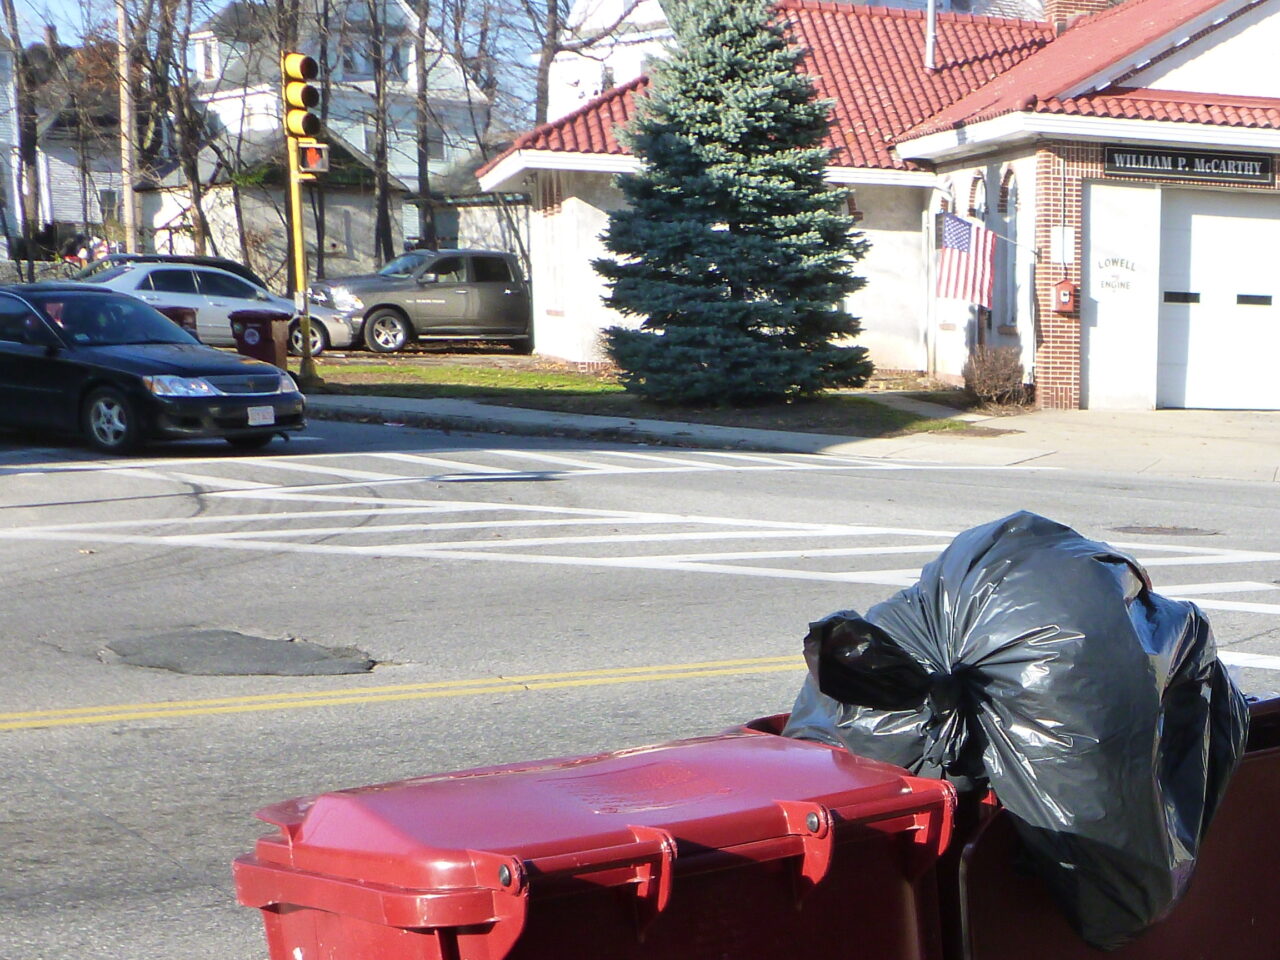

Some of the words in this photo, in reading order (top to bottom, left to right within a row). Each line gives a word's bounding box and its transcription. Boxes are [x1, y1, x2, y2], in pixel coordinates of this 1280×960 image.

[1113, 153, 1172, 170] WILLIAM
[1177, 157, 1189, 171] P.
[1193, 158, 1263, 175] McCARTHY
[1098, 258, 1136, 272] LOWELL
